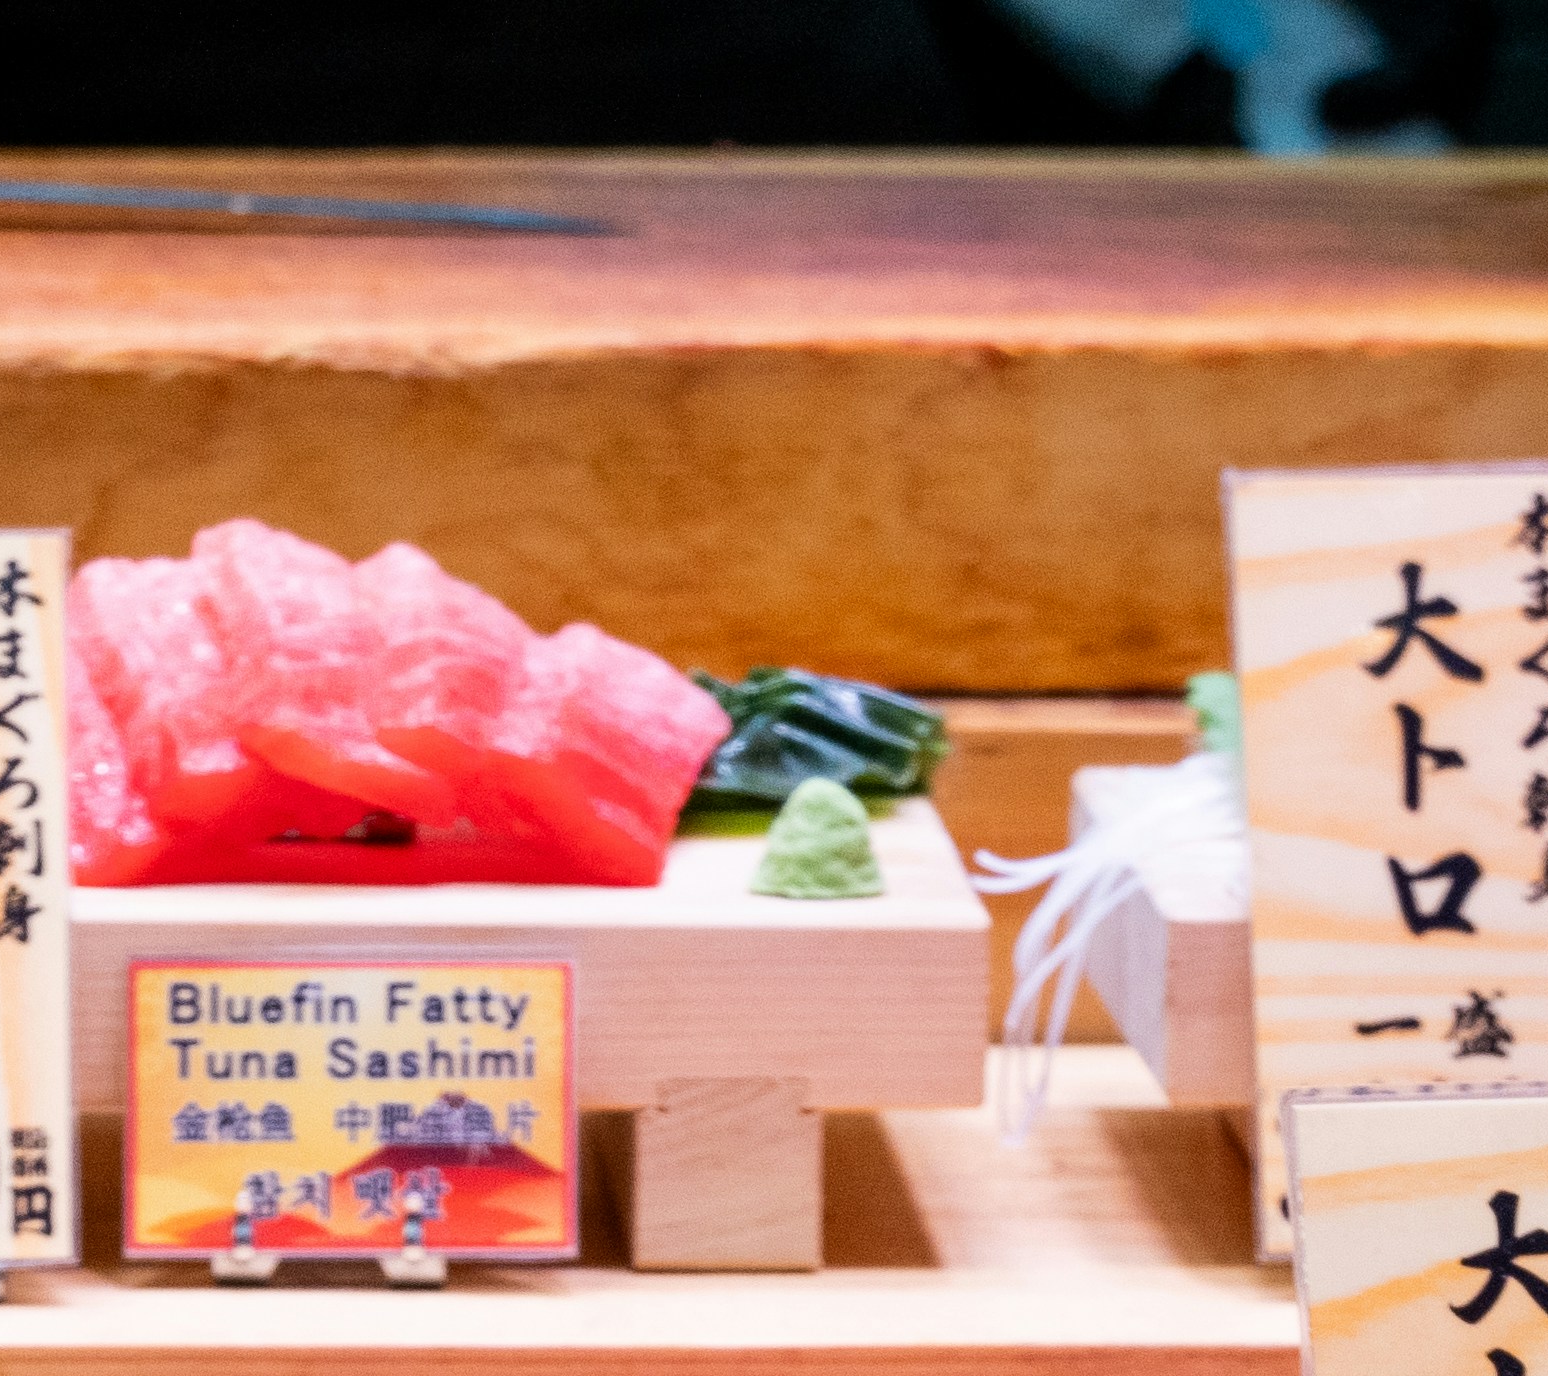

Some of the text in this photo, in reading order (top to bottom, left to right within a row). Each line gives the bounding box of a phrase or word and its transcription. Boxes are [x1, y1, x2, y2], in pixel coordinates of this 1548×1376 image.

[1368, 563, 1483, 935] 大トロ
[168, 982, 529, 1029] Bluefin Fatty
[1357, 992, 1513, 1057] 一盛
[169, 1037, 535, 1079] Tuna Sashimi
[14, 1186, 51, 1235] 円
